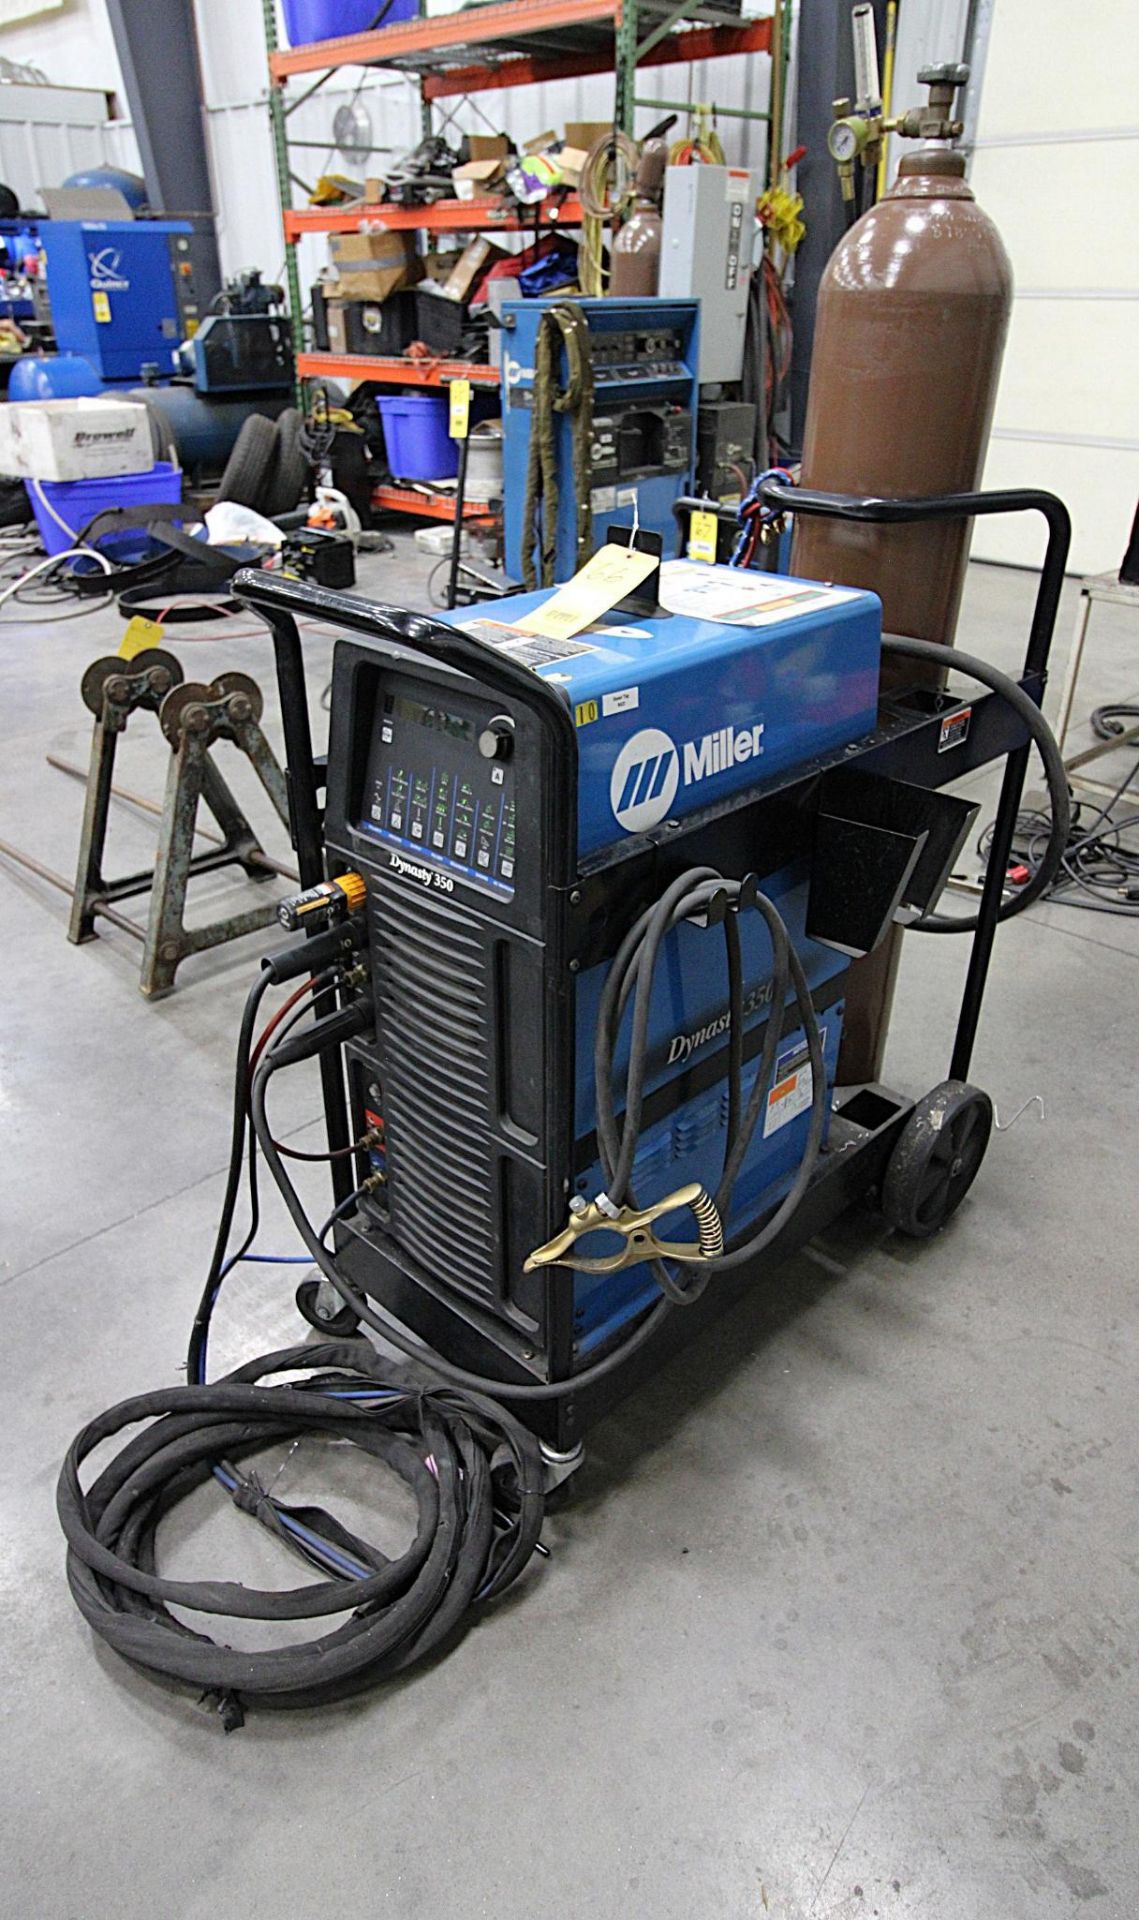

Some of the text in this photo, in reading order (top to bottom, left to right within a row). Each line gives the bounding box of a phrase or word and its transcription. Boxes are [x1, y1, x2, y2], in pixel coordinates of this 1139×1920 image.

[727, 254, 738, 289] OFF
[579, 702, 596, 724] 10
[683, 723, 765, 786] Miller
[389, 853, 434, 886] Dynasty
[434, 873, 454, 892] 350
[666, 1009, 731, 1065] Dynast
